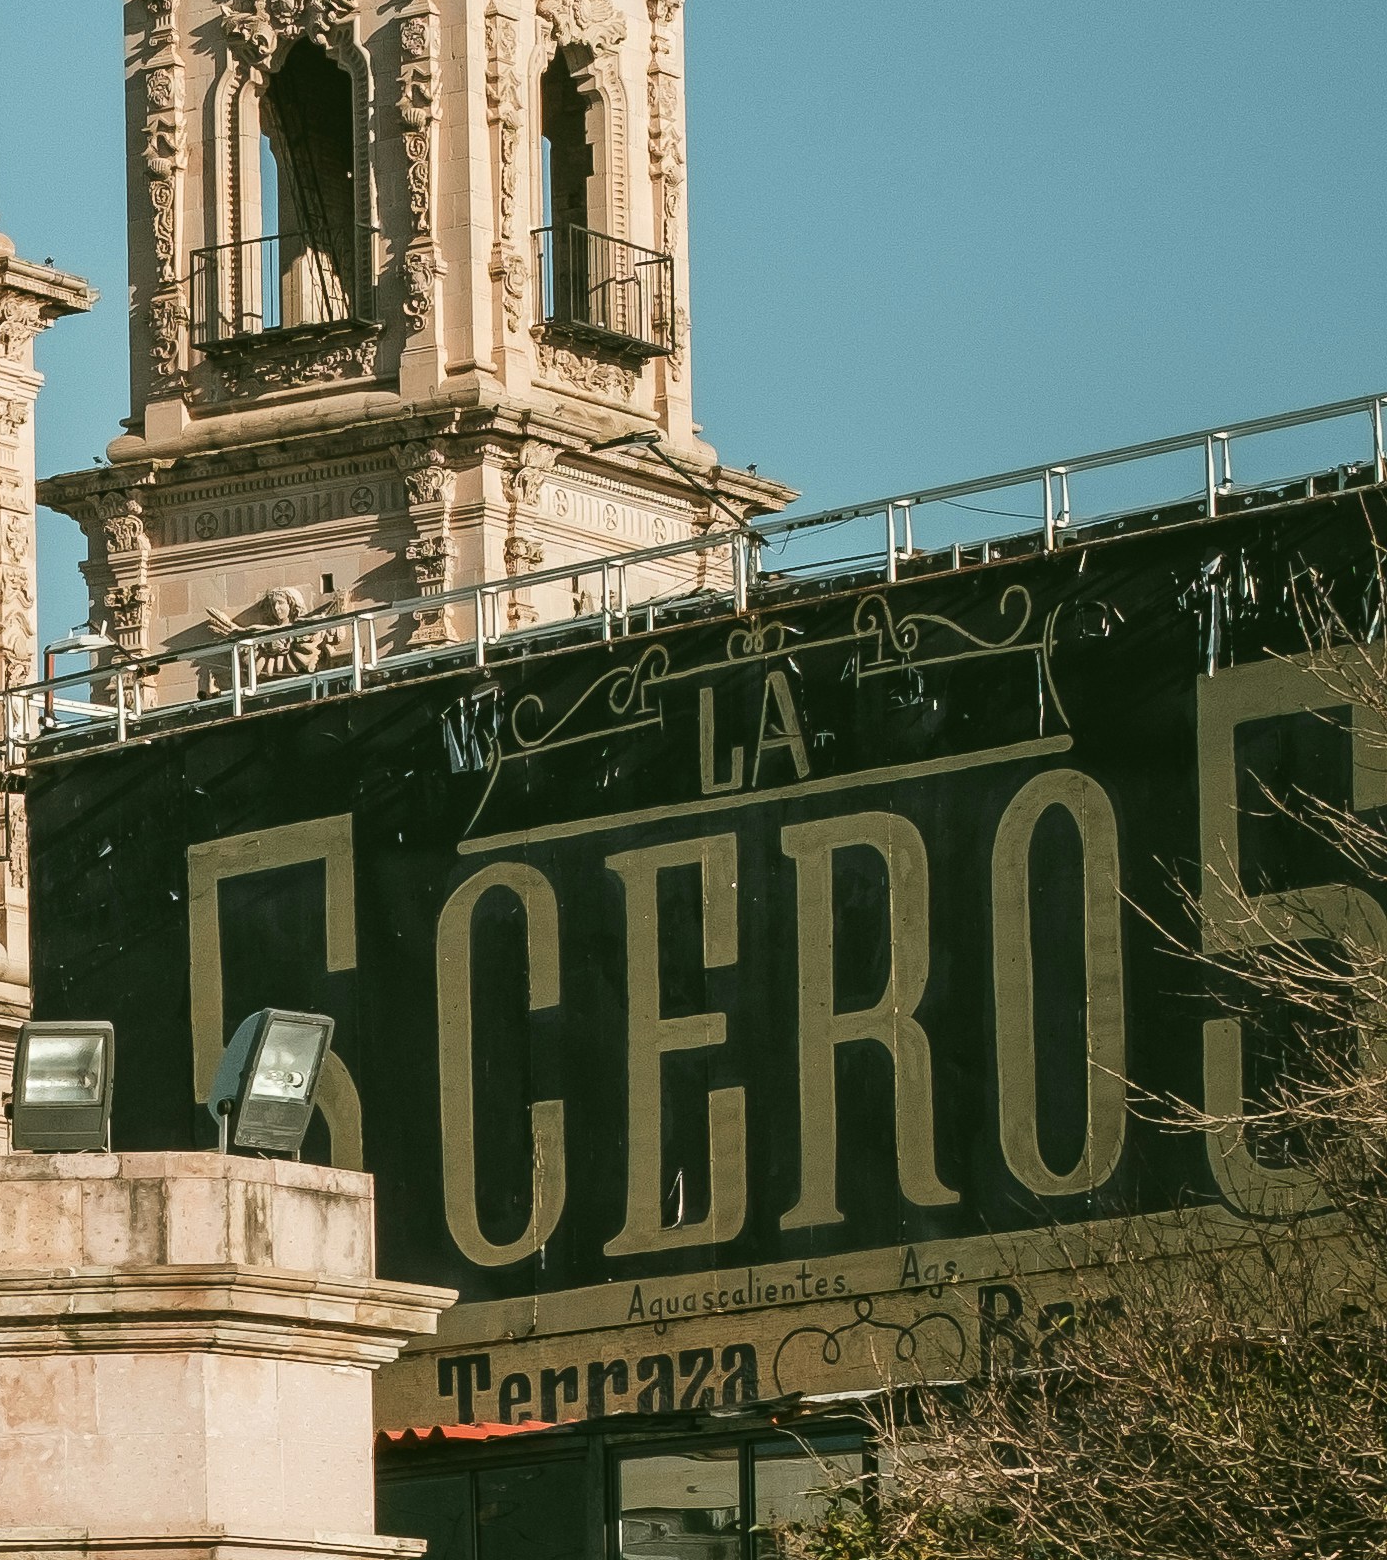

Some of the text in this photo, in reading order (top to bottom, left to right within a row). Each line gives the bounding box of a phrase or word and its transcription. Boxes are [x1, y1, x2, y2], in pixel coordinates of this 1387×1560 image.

[699, 666, 812, 795] LA
[436, 767, 1128, 1269] CERO
[436, 1342, 760, 1425] Terraza
